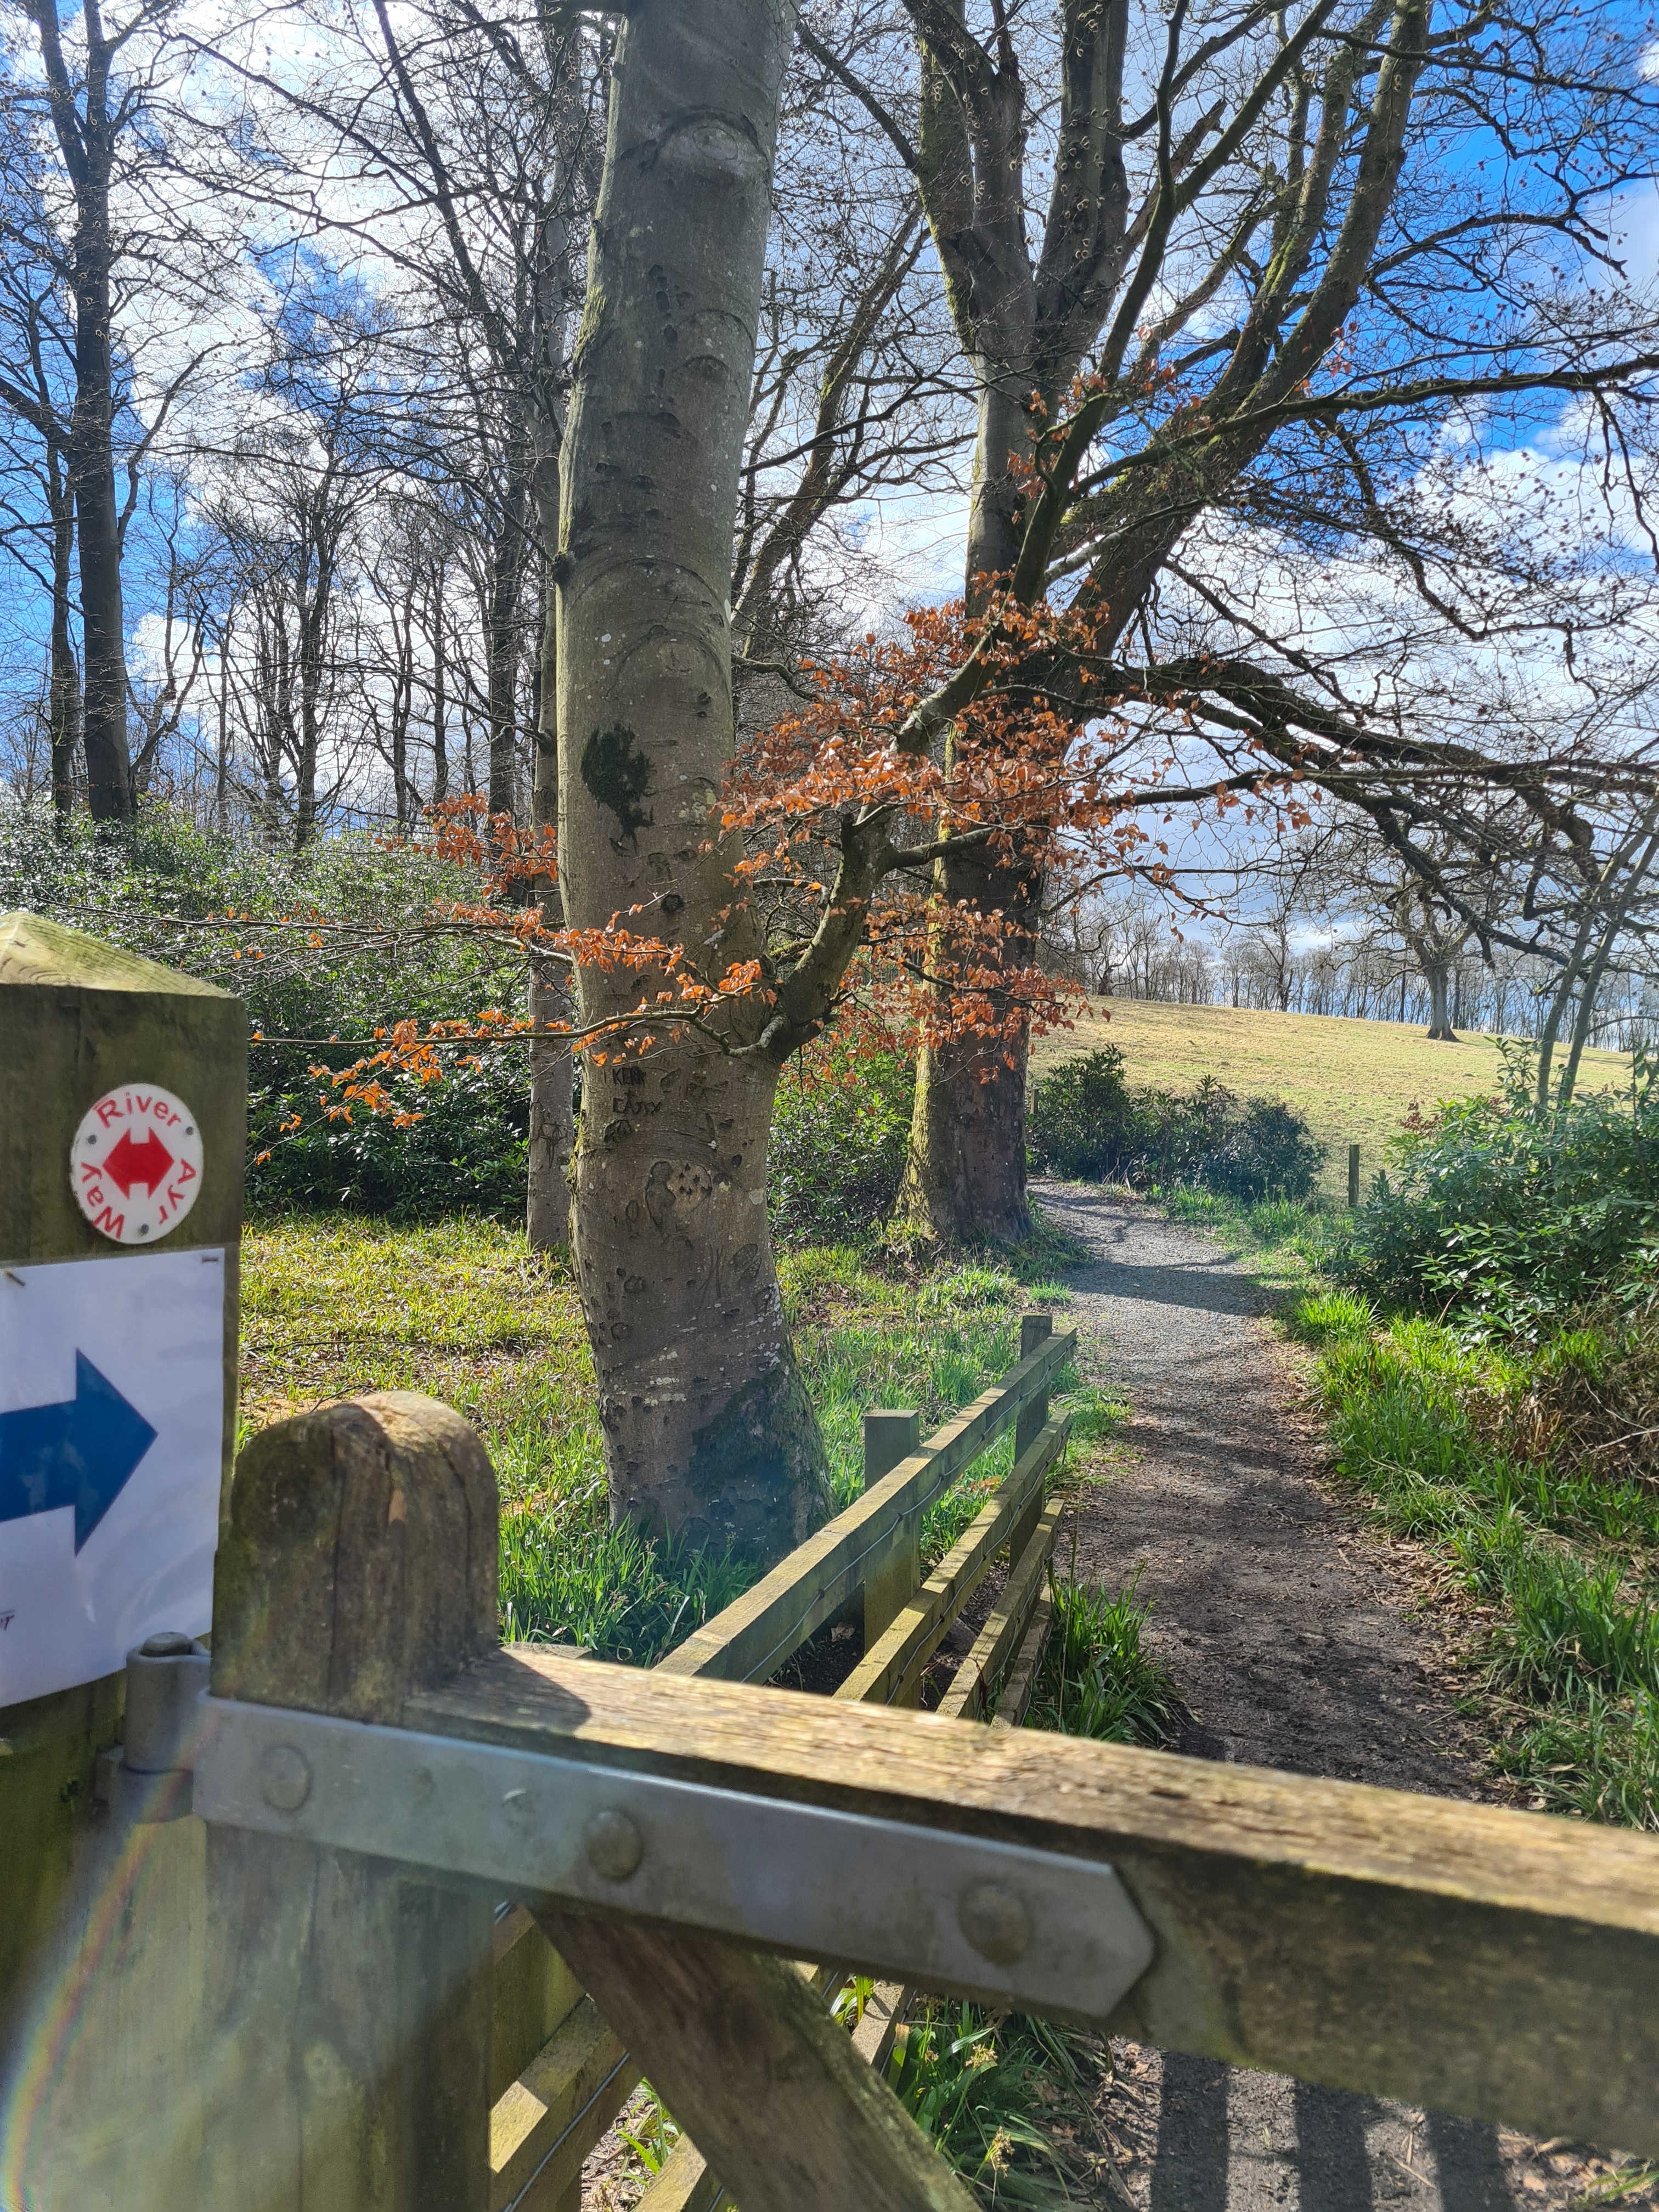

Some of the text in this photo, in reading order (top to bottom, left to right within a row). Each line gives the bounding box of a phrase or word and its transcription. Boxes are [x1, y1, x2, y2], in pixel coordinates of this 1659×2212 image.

[80, 1092, 197, 1240] River Ayr Way
